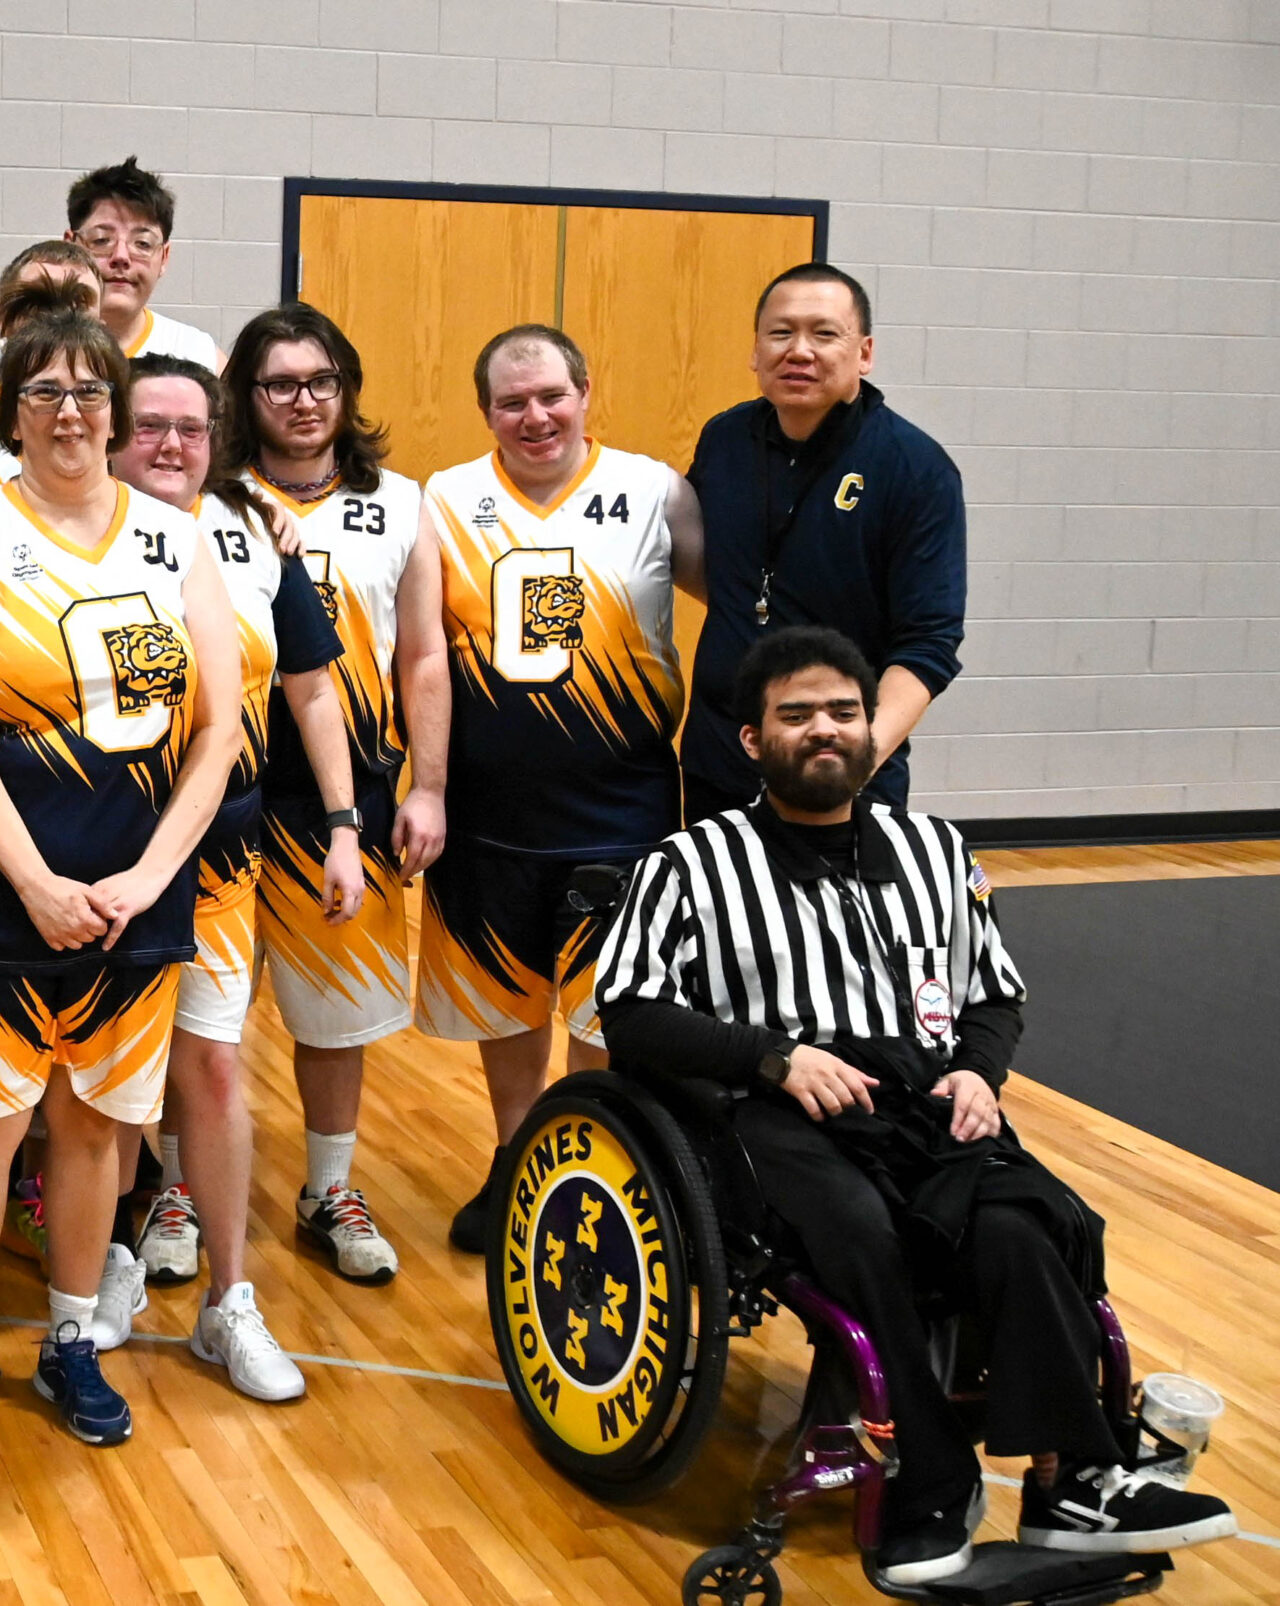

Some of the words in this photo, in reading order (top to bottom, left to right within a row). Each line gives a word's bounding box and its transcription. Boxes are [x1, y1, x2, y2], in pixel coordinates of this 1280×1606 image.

[343, 498, 385, 536] 23
[584, 493, 629, 525] 44
[834, 472, 864, 511] C
[213, 529, 250, 563] 13
[491, 547, 576, 685] C
[58, 591, 178, 753] C
[576, 1191, 603, 1254] M
[509, 1122, 593, 1415] WOLVERINES
[542, 1231, 566, 1292] M
[597, 1171, 668, 1442] MICHIGAN
[599, 1274, 629, 1337] M
[564, 1308, 589, 1370] M
